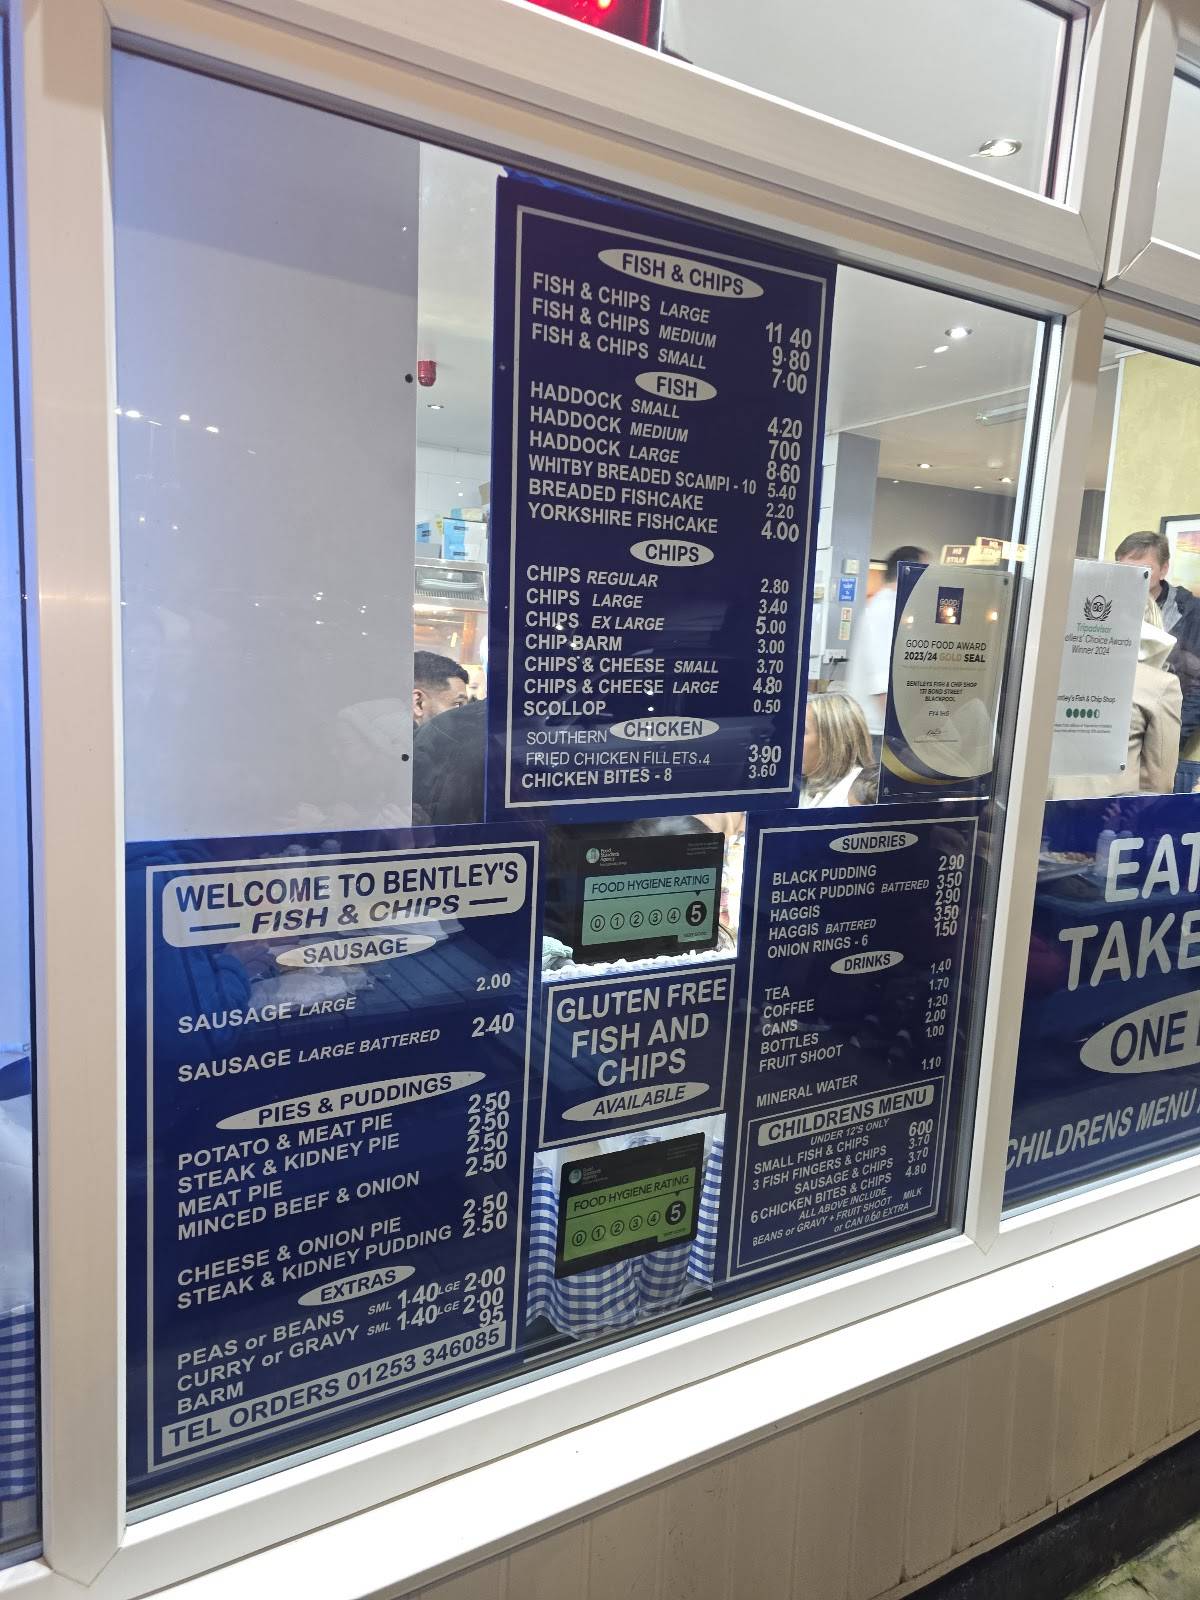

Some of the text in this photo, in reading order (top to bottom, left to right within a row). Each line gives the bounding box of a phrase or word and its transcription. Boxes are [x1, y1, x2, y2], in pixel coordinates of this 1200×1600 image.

[623, 253, 743, 295] FISH CHIPS
[533, 272, 710, 324] FISH CHIPS LARGE
[533, 297, 717, 348] FISH CHIPS MEDIUM
[532, 322, 706, 370] FISH CHIPS SMALL
[657, 376, 697, 398] FISH
[530, 405, 688, 442] HADDOCK MEDIUM
[531, 381, 802, 439] HADDOCK SMALL 4.20
[530, 430, 680, 464] HADDOCK LARGE
[529, 454, 796, 500] WHITBY BREADED SCAMPI 10 5.40
[529, 478, 794, 519] BREADED FISHCAKE 2.20
[528, 502, 799, 542] YORKSHIRE FISHCAKE 4.00
[586, 571, 789, 594] REGULAR 2.80
[759, 598, 788, 615] 3.40
[591, 616, 786, 635] EX 5.00
[1085, 634, 1132, 647] Choice Awards
[904, 651, 938, 662] 2023/24
[964, 654, 986, 663] SEAL
[906, 639, 987, 651] GOOD FOOD AWARD
[1071, 645, 1110, 655] Winner 2024
[599, 657, 664, 673] CHEESE
[599, 679, 664, 696] CHEESE
[524, 700, 606, 716] SCOLLOP
[624, 721, 703, 737] CHICKEN
[522, 763, 776, 788] CHICKEN BITES 3.60
[842, 834, 906, 850] SUNDRIES
[176, 861, 518, 912] WELCOME TO BENTLEY'S
[592, 874, 709, 894] FOOD HYGIENE RATING
[773, 865, 876, 885] BLACK PUDDING
[771, 882, 875, 904] BLACK PUDDING
[770, 905, 820, 922] HAGGIS
[768, 936, 851, 958] ONION RINGS
[769, 923, 819, 940] HAGGIS
[303, 937, 408, 964] SAUSAGE
[844, 953, 891, 971] DRINKS
[177, 973, 511, 1034] SAUSAGE 2.00
[557, 978, 727, 1022] GLUTEN FREE
[763, 999, 814, 1021] COFFEE
[571, 1013, 709, 1058] FISH AND
[761, 1033, 819, 1054] BOTTLES
[762, 1019, 798, 1036] CANS
[1110, 1010, 1188, 1067] ONE
[178, 1029, 440, 1082] SAUSAGE BATTERED
[759, 1044, 843, 1072] FRUIT SHOOT
[259, 1075, 452, 1125] PIES PUDDINGS
[593, 1085, 686, 1116] AVAILABLE
[756, 1075, 858, 1108] MINERAL WATER
[768, 1089, 927, 1142] CHILDRENS MENU
[1136, 1088, 1198, 1132] MENU
[178, 1113, 392, 1170] POTATO MEAT PIE
[810, 1118, 890, 1146] UNDER ONLY
[178, 1133, 399, 1194] STEAK KIDNEY PIE
[754, 1155, 794, 1175] SMALL
[792, 1157, 841, 1180] FINGERS
[574, 1174, 689, 1212] FOOD HYGIENE RATING
[792, 1167, 849, 1196] SAUSAGE
[178, 1180, 282, 1218] MEAT PIE
[178, 1171, 419, 1240] MINCED BEEF ONION
[760, 1185, 847, 1220] CHICKEN BITES
[798, 1186, 887, 1220] ALL ABOVE INCLUDE
[845, 1202, 909, 1229] CAN EXTRA
[753, 1196, 892, 1247] BEANS GRAVY FRUIT SHOOT
[177, 1222, 451, 1311] STEAK KIDNEY PUDDING
[178, 1217, 401, 1286] CHEESE ONION PIE
[321, 1270, 396, 1302] EXTRAS
[178, 1309, 347, 1370] PEAS BEANS
[177, 1325, 359, 1393] CURRY GRAVY
[178, 1304, 505, 1415] BARM 95
[168, 1327, 499, 1447] TEL ORDERS 01253 346085
